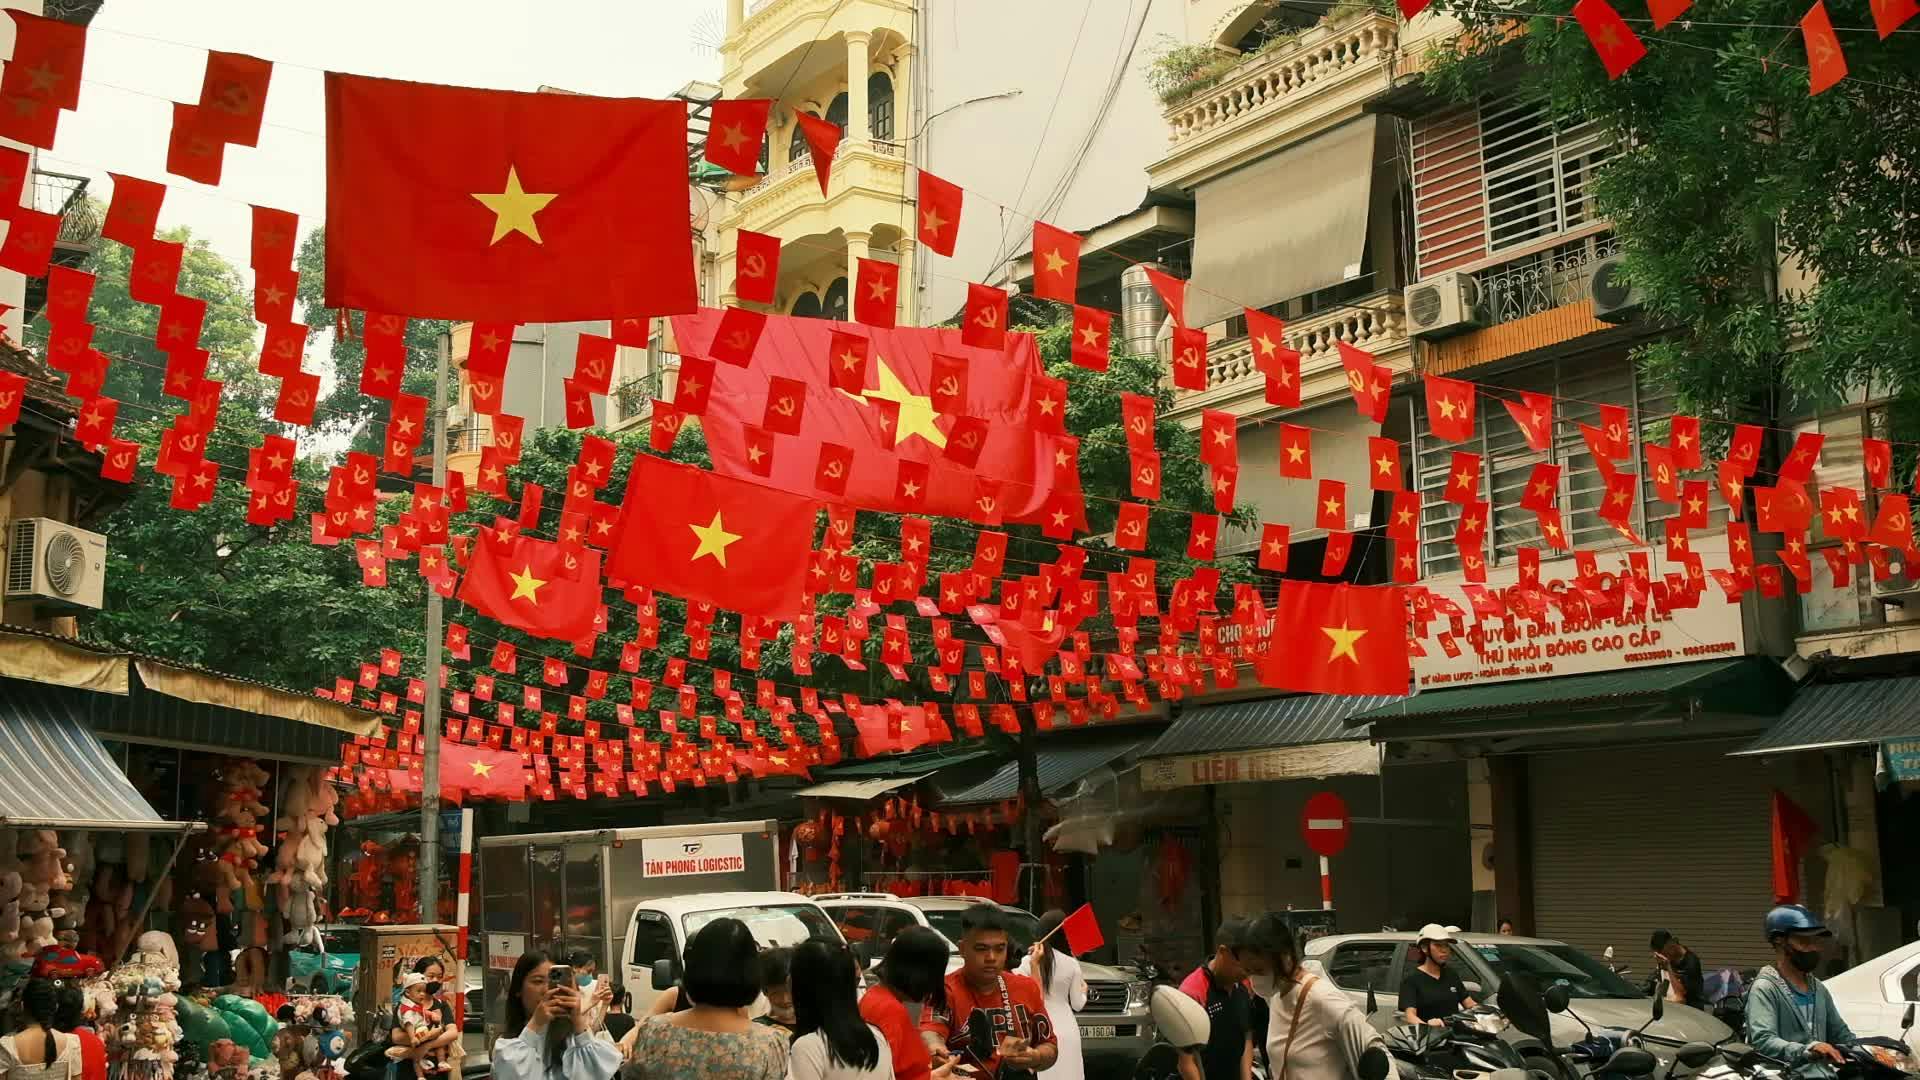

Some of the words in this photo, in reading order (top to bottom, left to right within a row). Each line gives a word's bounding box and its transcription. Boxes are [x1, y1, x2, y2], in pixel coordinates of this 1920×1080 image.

[1546, 638, 1587, 658] BÔNG
[1592, 634, 1624, 653] CAO
[665, 859, 697, 874] PHONG
[698, 856, 743, 873] LOGICSTIC
